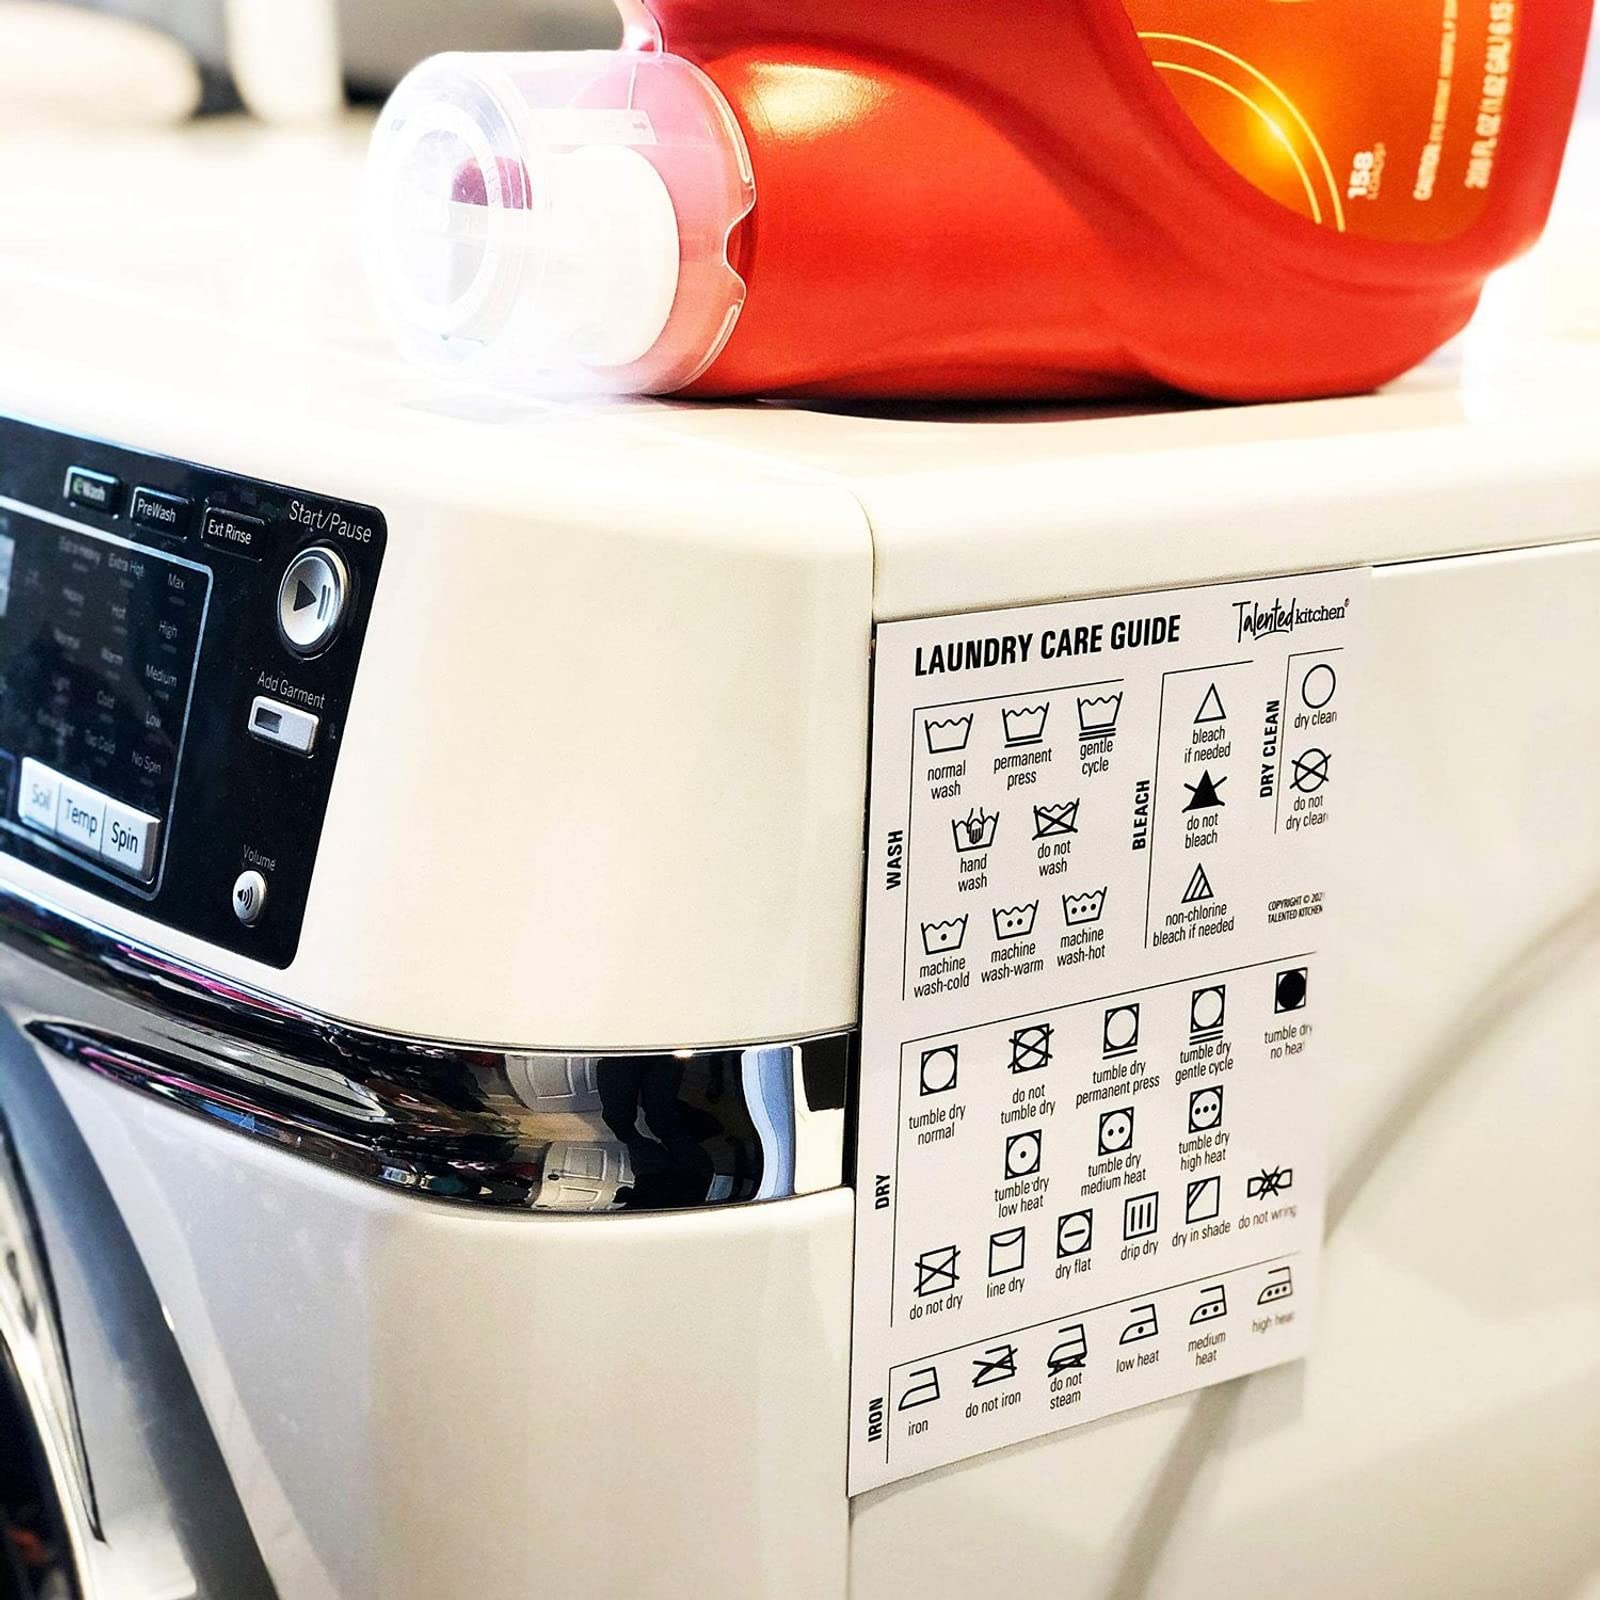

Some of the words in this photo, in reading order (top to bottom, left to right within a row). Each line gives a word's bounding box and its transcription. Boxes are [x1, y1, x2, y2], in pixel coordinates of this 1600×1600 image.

[1347, 151, 1374, 199] 158
[137, 499, 176, 523] PreWash
[288, 501, 372, 542] Start/Pause
[208, 520, 223, 537] Ext
[225, 523, 251, 544] Rinse
[168, 573, 185, 590] Max
[159, 620, 177, 638] High
[1232, 598, 1296, 643] Talented
[914, 634, 1033, 676] LAUNDRY
[1040, 624, 1103, 659] CARE
[1110, 615, 1181, 649] GUIDE
[145, 665, 177, 687] Medium
[257, 671, 278, 692] Add
[280, 681, 326, 709] Garment
[145, 712, 162, 728] Low
[1263, 700, 1280, 757] CLEAN
[1294, 713, 1309, 730] dry
[1312, 710, 1337, 726] clean
[1192, 726, 1226, 745] bleach
[994, 748, 1052, 774] permanent
[1080, 738, 1113, 761] gentle
[1184, 748, 1194, 764] if
[1194, 742, 1230, 761] needed
[144, 756, 162, 775] Spin
[927, 761, 966, 782] normal
[1082, 758, 1109, 777] cycle
[931, 781, 961, 800] wash
[1007, 769, 1037, 790] press
[1260, 764, 1274, 798] DRY
[1294, 796, 1305, 811] do
[1308, 795, 1323, 808] not
[65, 800, 98, 837] Temp
[1132, 780, 1150, 850] BLEACH
[1187, 817, 1199, 832] do
[1201, 813, 1218, 829] not
[1286, 815, 1301, 831] dry
[111, 822, 138, 854] Spin
[1037, 843, 1051, 859] do
[1053, 840, 1071, 857] not
[1185, 830, 1218, 850] bleach
[242, 845, 276, 871] Volume
[886, 829, 903, 890] WASH
[960, 854, 987, 873] hand
[1039, 858, 1068, 877] wash
[958, 874, 988, 892] wash
[1268, 896, 1302, 911] COPYRIGHT
[1165, 903, 1227, 928] non-chlorine
[1268, 909, 1297, 923] TALENTED
[1060, 928, 1104, 949] machine
[1153, 928, 1185, 947] bleach
[1187, 925, 1197, 940] if
[1198, 917, 1234, 938] needed
[991, 942, 1036, 964] machine
[1057, 945, 1106, 968] wash-hot
[919, 957, 966, 978] machine
[981, 958, 1044, 984] wash-warm
[914, 973, 970, 999] wash-cold
[1264, 1025, 1297, 1044] tumble
[1180, 1042, 1212, 1064] tumble
[1214, 1039, 1232, 1060] dry
[1270, 1047, 1282, 1059] no
[1285, 1042, 1304, 1055] hea
[1092, 1064, 1127, 1085] tumble
[1128, 1060, 1146, 1080] dry
[1175, 1063, 1207, 1085] gentle
[1209, 1057, 1234, 1075] cycle
[1012, 1089, 1026, 1104] do
[1028, 1084, 1045, 1101] not
[1076, 1079, 1130, 1108] permanent
[1132, 1075, 1160, 1095] press
[909, 1107, 946, 1129] tumble
[948, 1104, 966, 1125] dry
[1001, 1103, 1035, 1125] tumble
[1037, 1100, 1055, 1120] dry
[918, 1125, 955, 1146] normal
[1178, 1134, 1211, 1156] tumble
[1212, 1132, 1230, 1151] dry
[1088, 1157, 1123, 1178] tumble
[1124, 1153, 1141, 1172] dry
[1180, 1152, 1202, 1173] high
[1204, 1148, 1227, 1165] heat
[875, 1175, 891, 1210] DRY
[995, 1182, 1030, 1203] tumble
[1030, 1176, 1049, 1196] dry
[1080, 1173, 1121, 1196] medium
[1123, 1168, 1146, 1186] heat
[998, 1199, 1018, 1218] low
[1020, 1194, 1044, 1214] heat
[1239, 1216, 1250, 1229] do
[1253, 1211, 1268, 1225] not
[1172, 1230, 1188, 1248] dry
[1190, 1227, 1199, 1241] in
[1201, 1220, 1231, 1239] shade
[1120, 1244, 1138, 1262] drip
[1141, 1238, 1159, 1258] dry
[1056, 1262, 1072, 1281] dry
[1074, 1258, 1092, 1274] flat
[986, 1281, 1006, 1299] line
[1008, 1277, 1025, 1296] dry
[910, 1303, 924, 1320] do
[926, 1301, 943, 1317] not
[945, 1293, 963, 1313] dry
[1188, 1331, 1226, 1352] medium
[1116, 1356, 1134, 1373] low
[1136, 1350, 1160, 1368] heat
[1195, 1350, 1217, 1366] heat
[1050, 1377, 1063, 1393] do
[1065, 1373, 1082, 1389] not
[965, 1402, 979, 1419] do
[981, 1398, 998, 1415] not
[1001, 1390, 1021, 1409] iron
[1049, 1391, 1081, 1410] steam
[868, 1398, 883, 1442] IRON
[907, 1420, 929, 1436] iron
